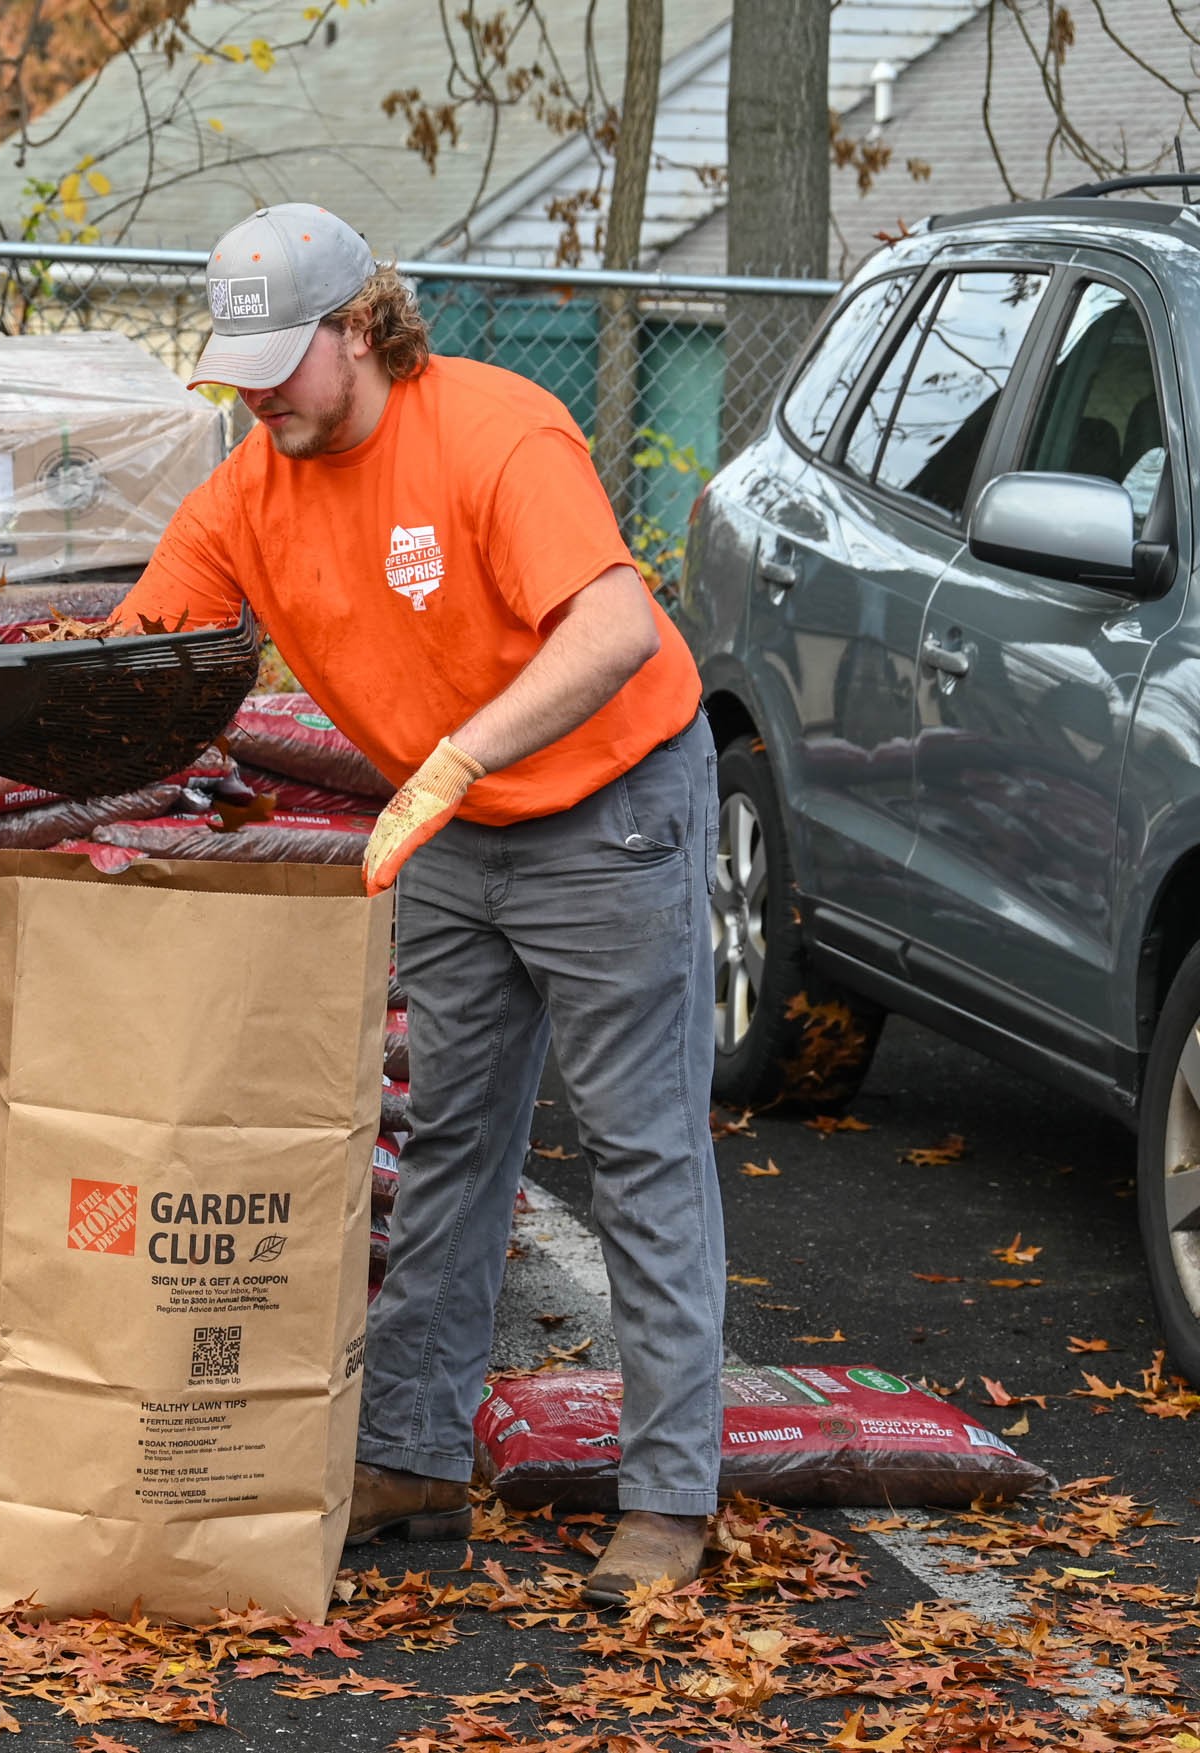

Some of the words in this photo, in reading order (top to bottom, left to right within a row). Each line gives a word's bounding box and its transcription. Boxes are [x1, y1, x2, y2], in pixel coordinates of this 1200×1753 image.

[232, 293, 261, 306] TEAM
[233, 303, 264, 316] DEPOT
[385, 546, 441, 567] OPERATION
[386, 559, 445, 588] SURPRISE
[76, 1188, 105, 1215] THE
[150, 1192, 291, 1225] GARDEN
[69, 1184, 137, 1250] HOME
[95, 1211, 136, 1252] DEPOT
[148, 1232, 236, 1265] CLUB
[151, 1275, 178, 1286] SIGN
[181, 1277, 197, 1287] UP
[199, 1277, 207, 1287] &
[209, 1277, 231, 1287] GET
[232, 1276, 240, 1286] A
[242, 1275, 289, 1285] COUPON
[171, 1288, 204, 1296] Delivered
[205, 1288, 213, 1296] to
[230, 1287, 251, 1296] Inbox,
[170, 1297, 181, 1306] Up
[182, 1297, 189, 1305] to
[216, 1296, 240, 1304] Annual
[156, 1305, 188, 1315] Regional
[188, 1305, 212, 1313] Advice
[213, 1305, 227, 1313] and
[253, 1304, 280, 1312] Projects
[188, 1378, 206, 1386] Scan
[215, 1377, 230, 1386] Sign
[231, 1377, 241, 1385] Up
[141, 1401, 189, 1413] HEALTHY
[192, 1401, 222, 1412] LAWN
[224, 1399, 247, 1409] TIPS
[146, 1418, 183, 1426] FERTILIZE
[185, 1416, 227, 1425] REGULARLY
[860, 1419, 901, 1428] PROUD
[905, 1421, 921, 1429] TO
[924, 1422, 940, 1430] BE
[728, 1431, 758, 1444] RED
[756, 1426, 804, 1442] MULCH
[863, 1426, 916, 1436] LOCALLY
[919, 1428, 954, 1437] MADE
[145, 1440, 166, 1448] SOAK
[168, 1438, 217, 1448] THOROUGHLY
[144, 1448, 158, 1456] Prep
[143, 1468, 159, 1476] USE
[189, 1467, 208, 1475] RULE
[142, 1490, 178, 1498] CONTROL
[180, 1489, 207, 1497] WEEDS
